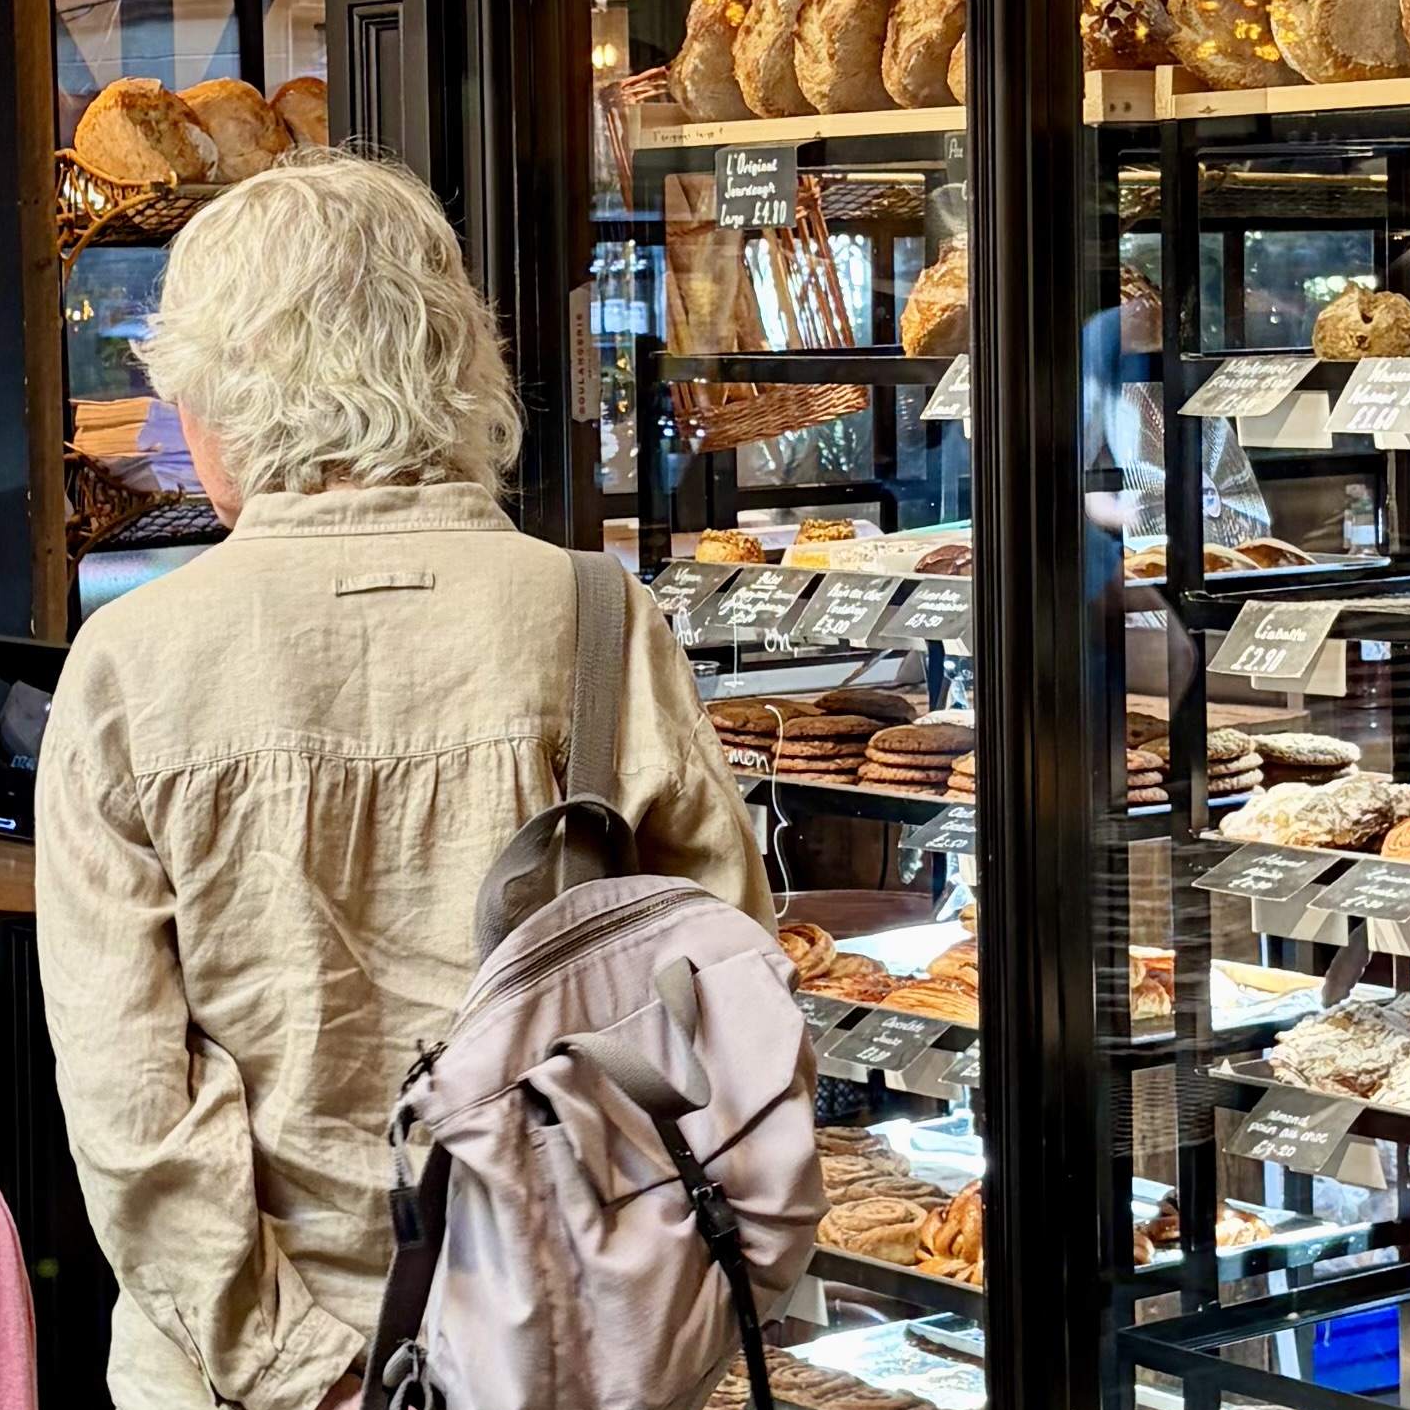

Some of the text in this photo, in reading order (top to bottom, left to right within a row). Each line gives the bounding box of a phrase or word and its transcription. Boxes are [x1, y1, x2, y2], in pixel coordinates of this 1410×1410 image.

[752, 200, 788, 226] £4.80
[1254, 613, 1307, 642] Ciabatta
[1230, 644, 1287, 673] £2.90
